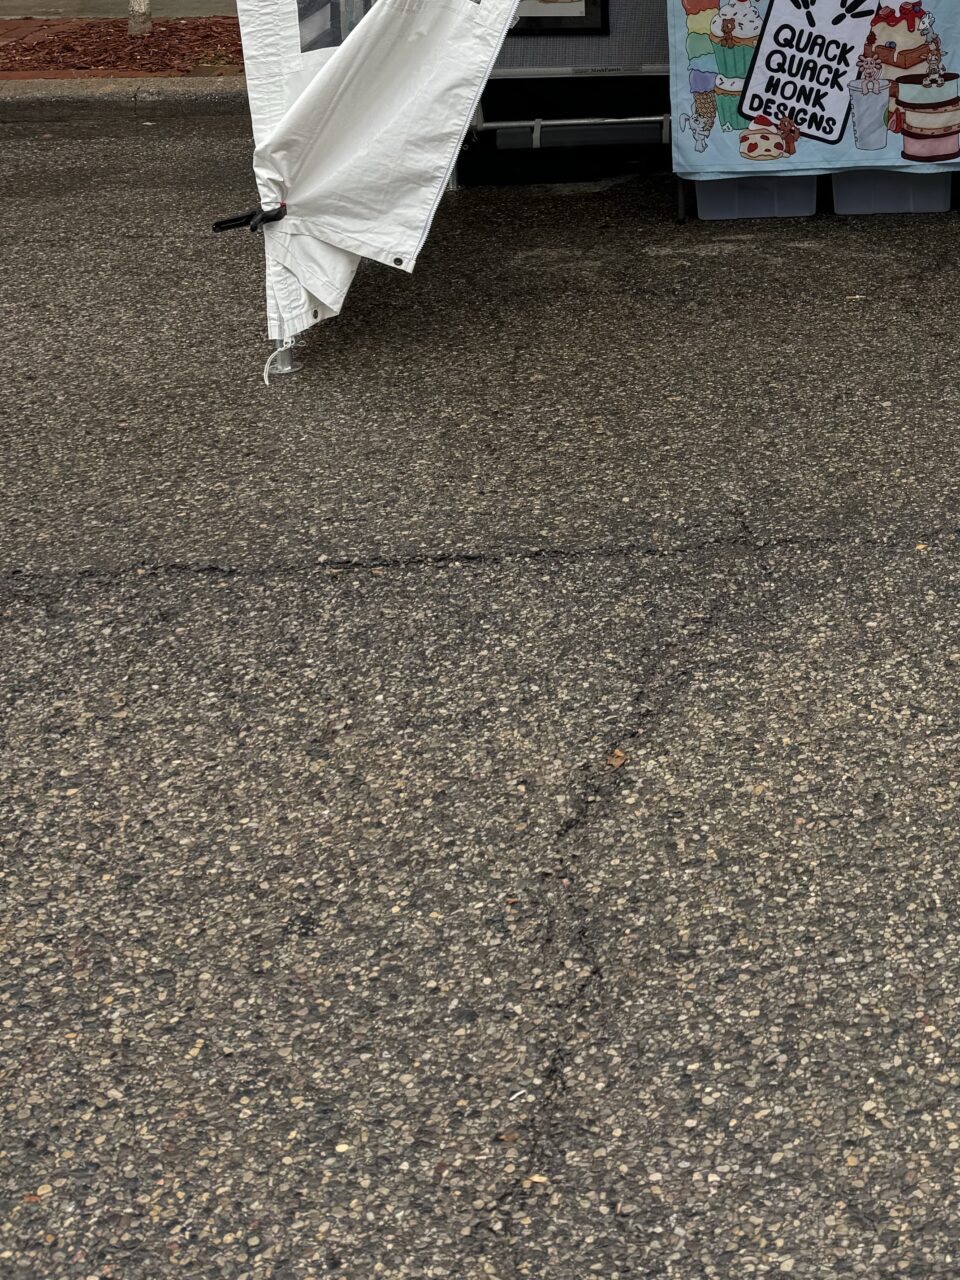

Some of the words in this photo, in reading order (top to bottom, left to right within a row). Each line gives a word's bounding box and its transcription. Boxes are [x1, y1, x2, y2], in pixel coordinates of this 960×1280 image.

[773, 24, 854, 67] QUACK
[765, 49, 847, 92] QUACK
[749, 94, 837, 135] DESIGNS
[765, 75, 828, 112] HONK
